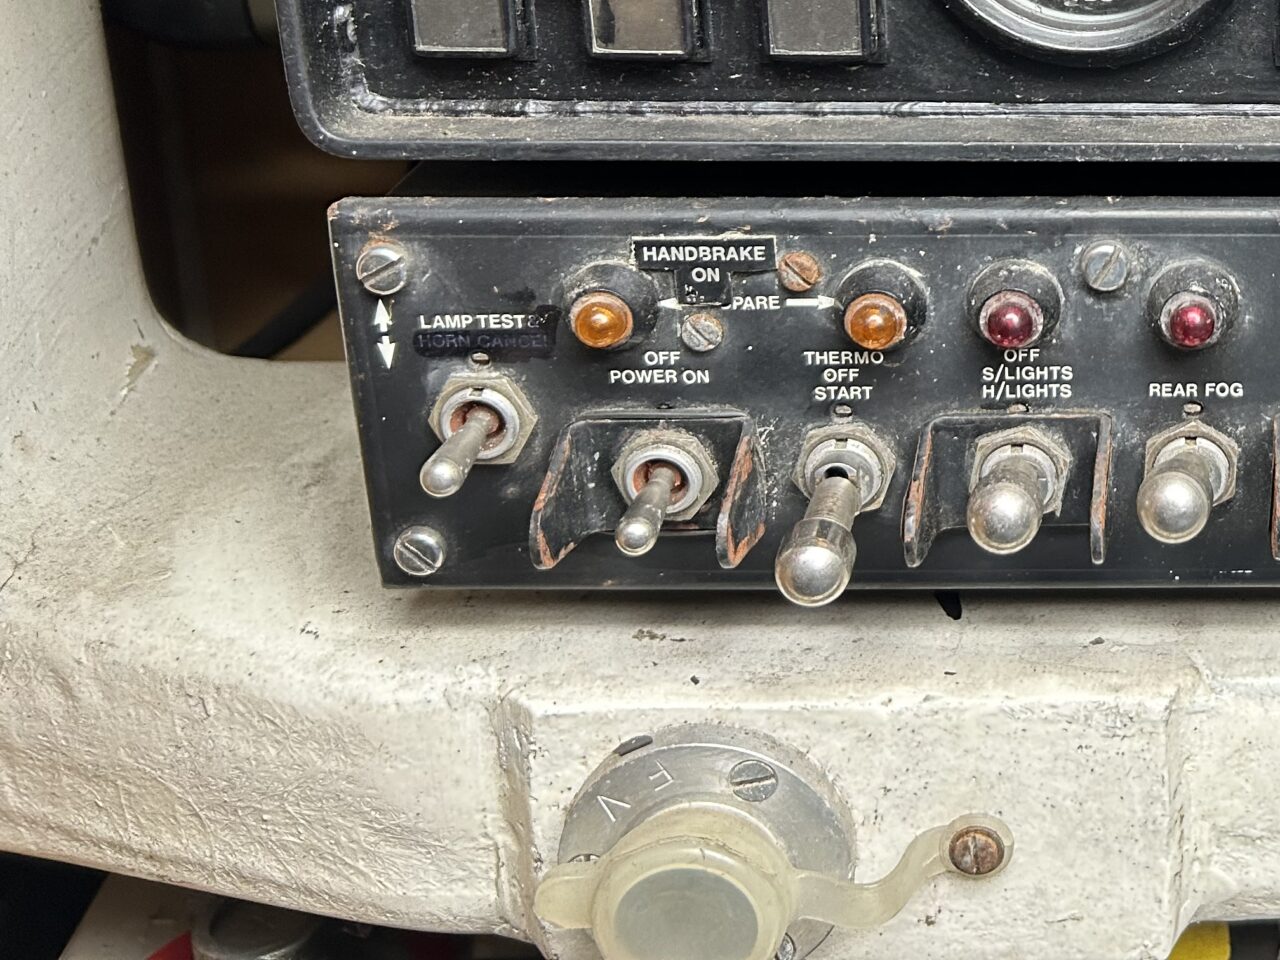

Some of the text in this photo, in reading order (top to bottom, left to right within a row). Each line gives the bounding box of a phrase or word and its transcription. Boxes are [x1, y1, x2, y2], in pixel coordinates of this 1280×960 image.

[642, 245, 766, 262] HANDBRAKE
[691, 267, 721, 283] ON
[721, 295, 781, 310] PARE
[419, 314, 472, 330] LAMP
[476, 313, 525, 329] TEST
[643, 350, 681, 367] OFF
[803, 350, 885, 366] THERMO
[1003, 348, 1041, 363] OFF
[610, 368, 710, 385] POWER ON
[823, 368, 859, 383] OFF
[982, 365, 1074, 382] S/LIGHTS
[814, 385, 873, 401] START
[982, 382, 1073, 400] H/LIGHTS
[1148, 382, 1245, 398] REAR FOG
